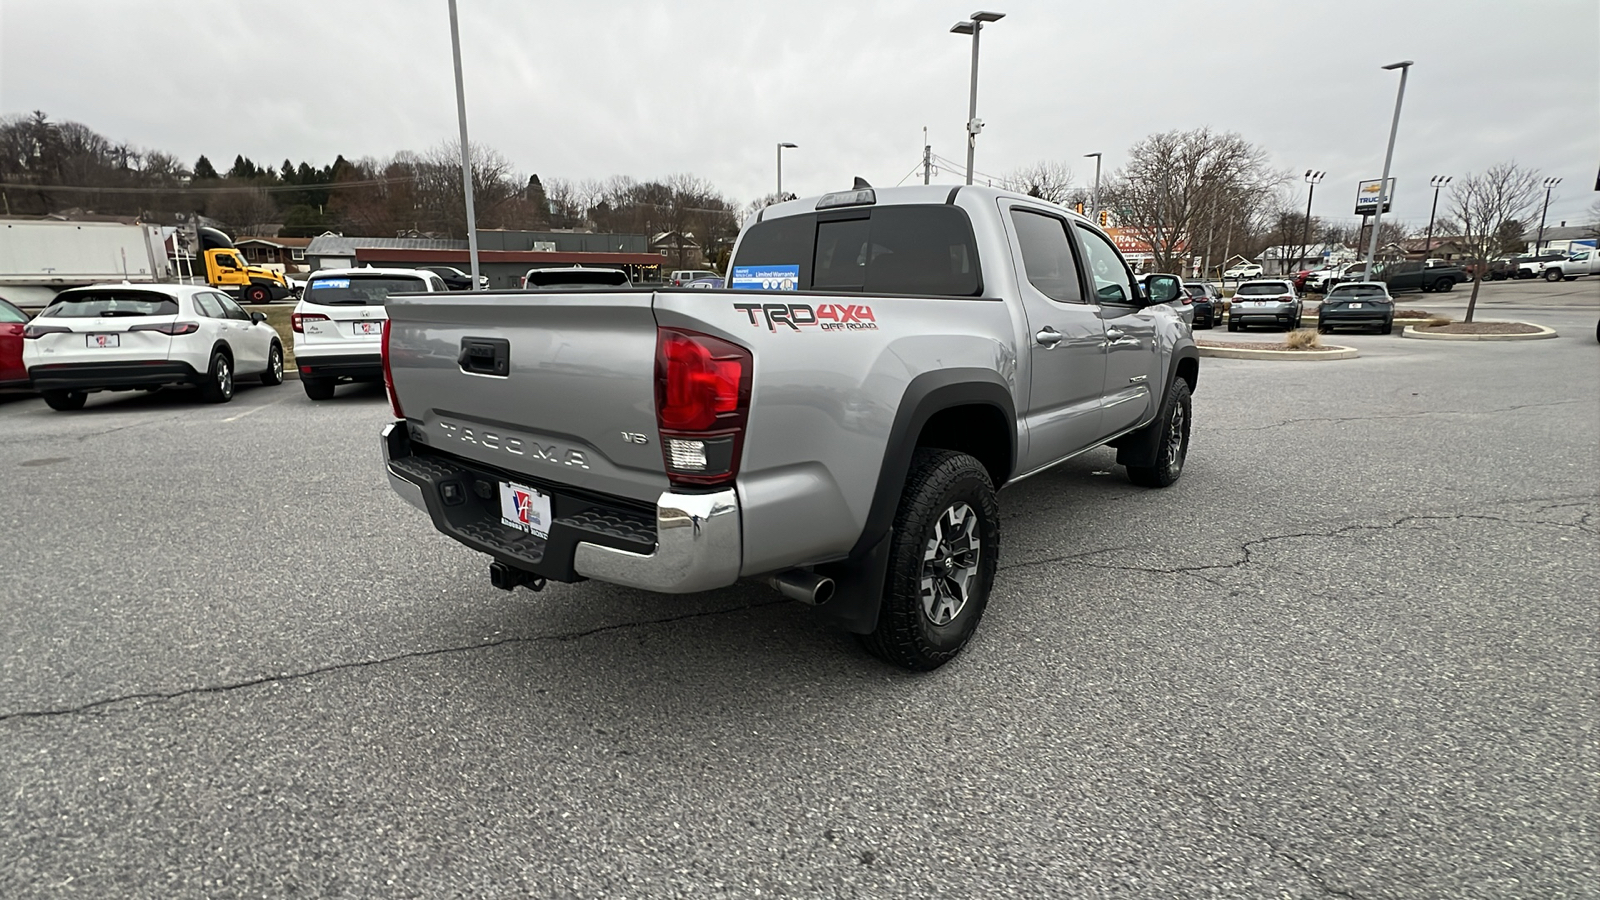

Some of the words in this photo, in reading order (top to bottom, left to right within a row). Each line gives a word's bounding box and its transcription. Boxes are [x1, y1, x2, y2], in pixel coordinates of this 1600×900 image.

[1359, 195, 1389, 203] TRUCS
[733, 303, 817, 333] TRD
[820, 322, 846, 332] OFF
[846, 322, 878, 332] ROAD
[620, 431, 649, 445] V6
[440, 422, 590, 470] TACOMA
